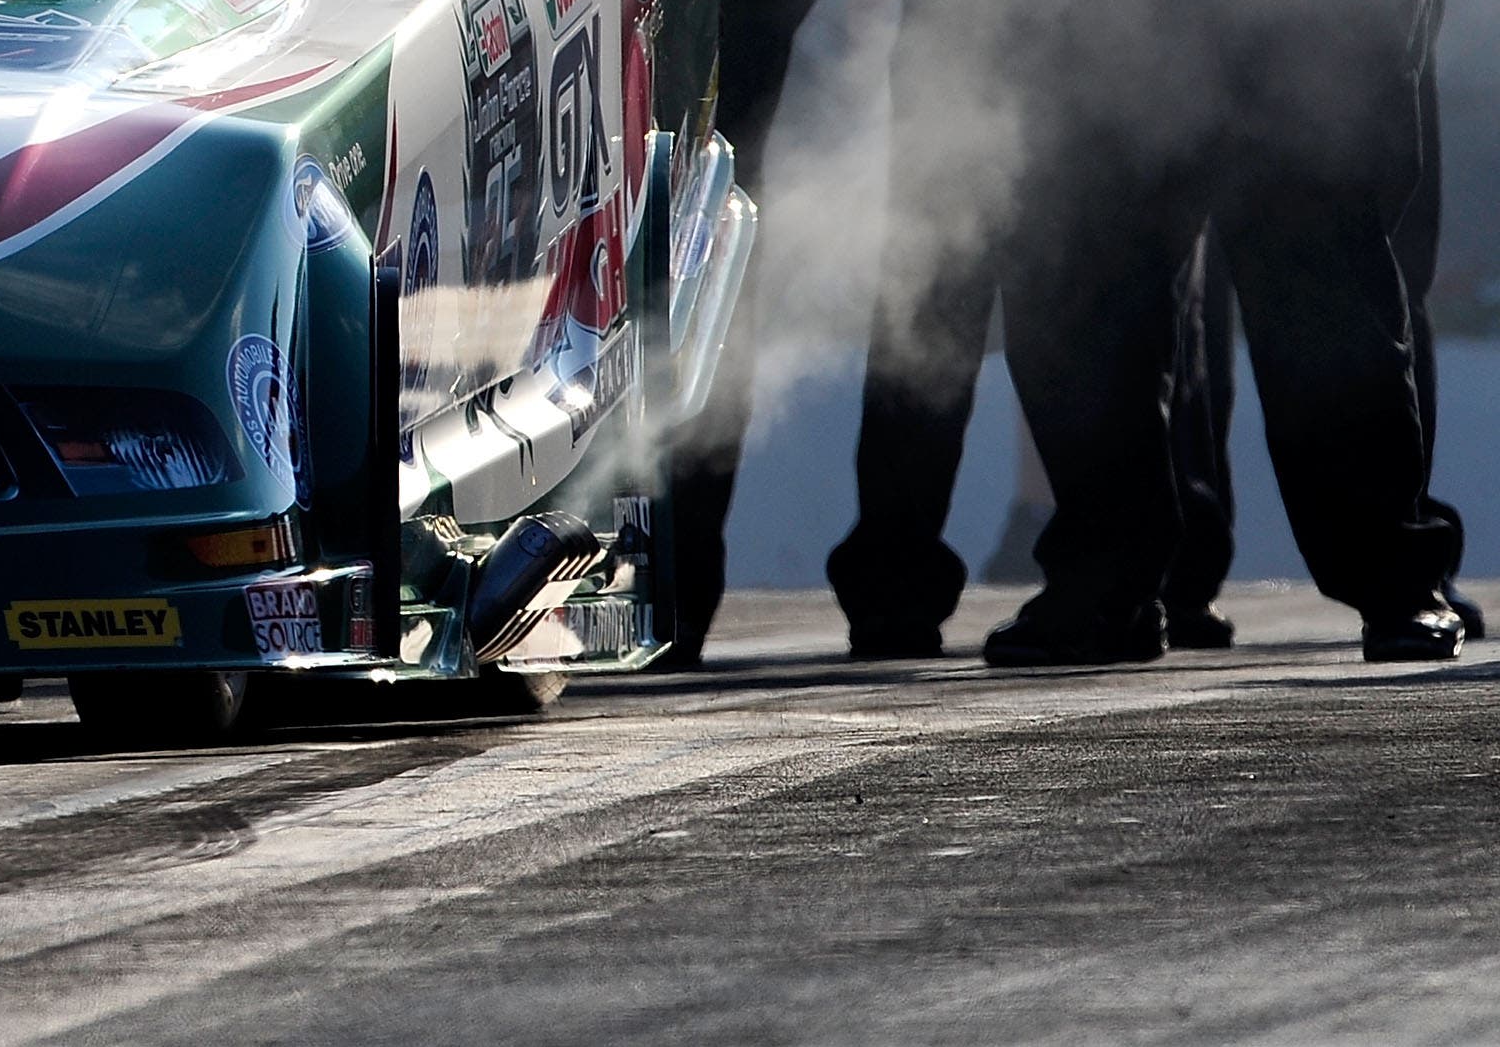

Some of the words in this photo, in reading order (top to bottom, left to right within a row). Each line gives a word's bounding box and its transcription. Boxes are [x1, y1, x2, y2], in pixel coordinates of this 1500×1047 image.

[549, 12, 612, 215] GTX
[235, 344, 275, 406] AUTOMOBILE
[19, 609, 168, 639] STANLEY
[252, 587, 317, 618] BRAND
